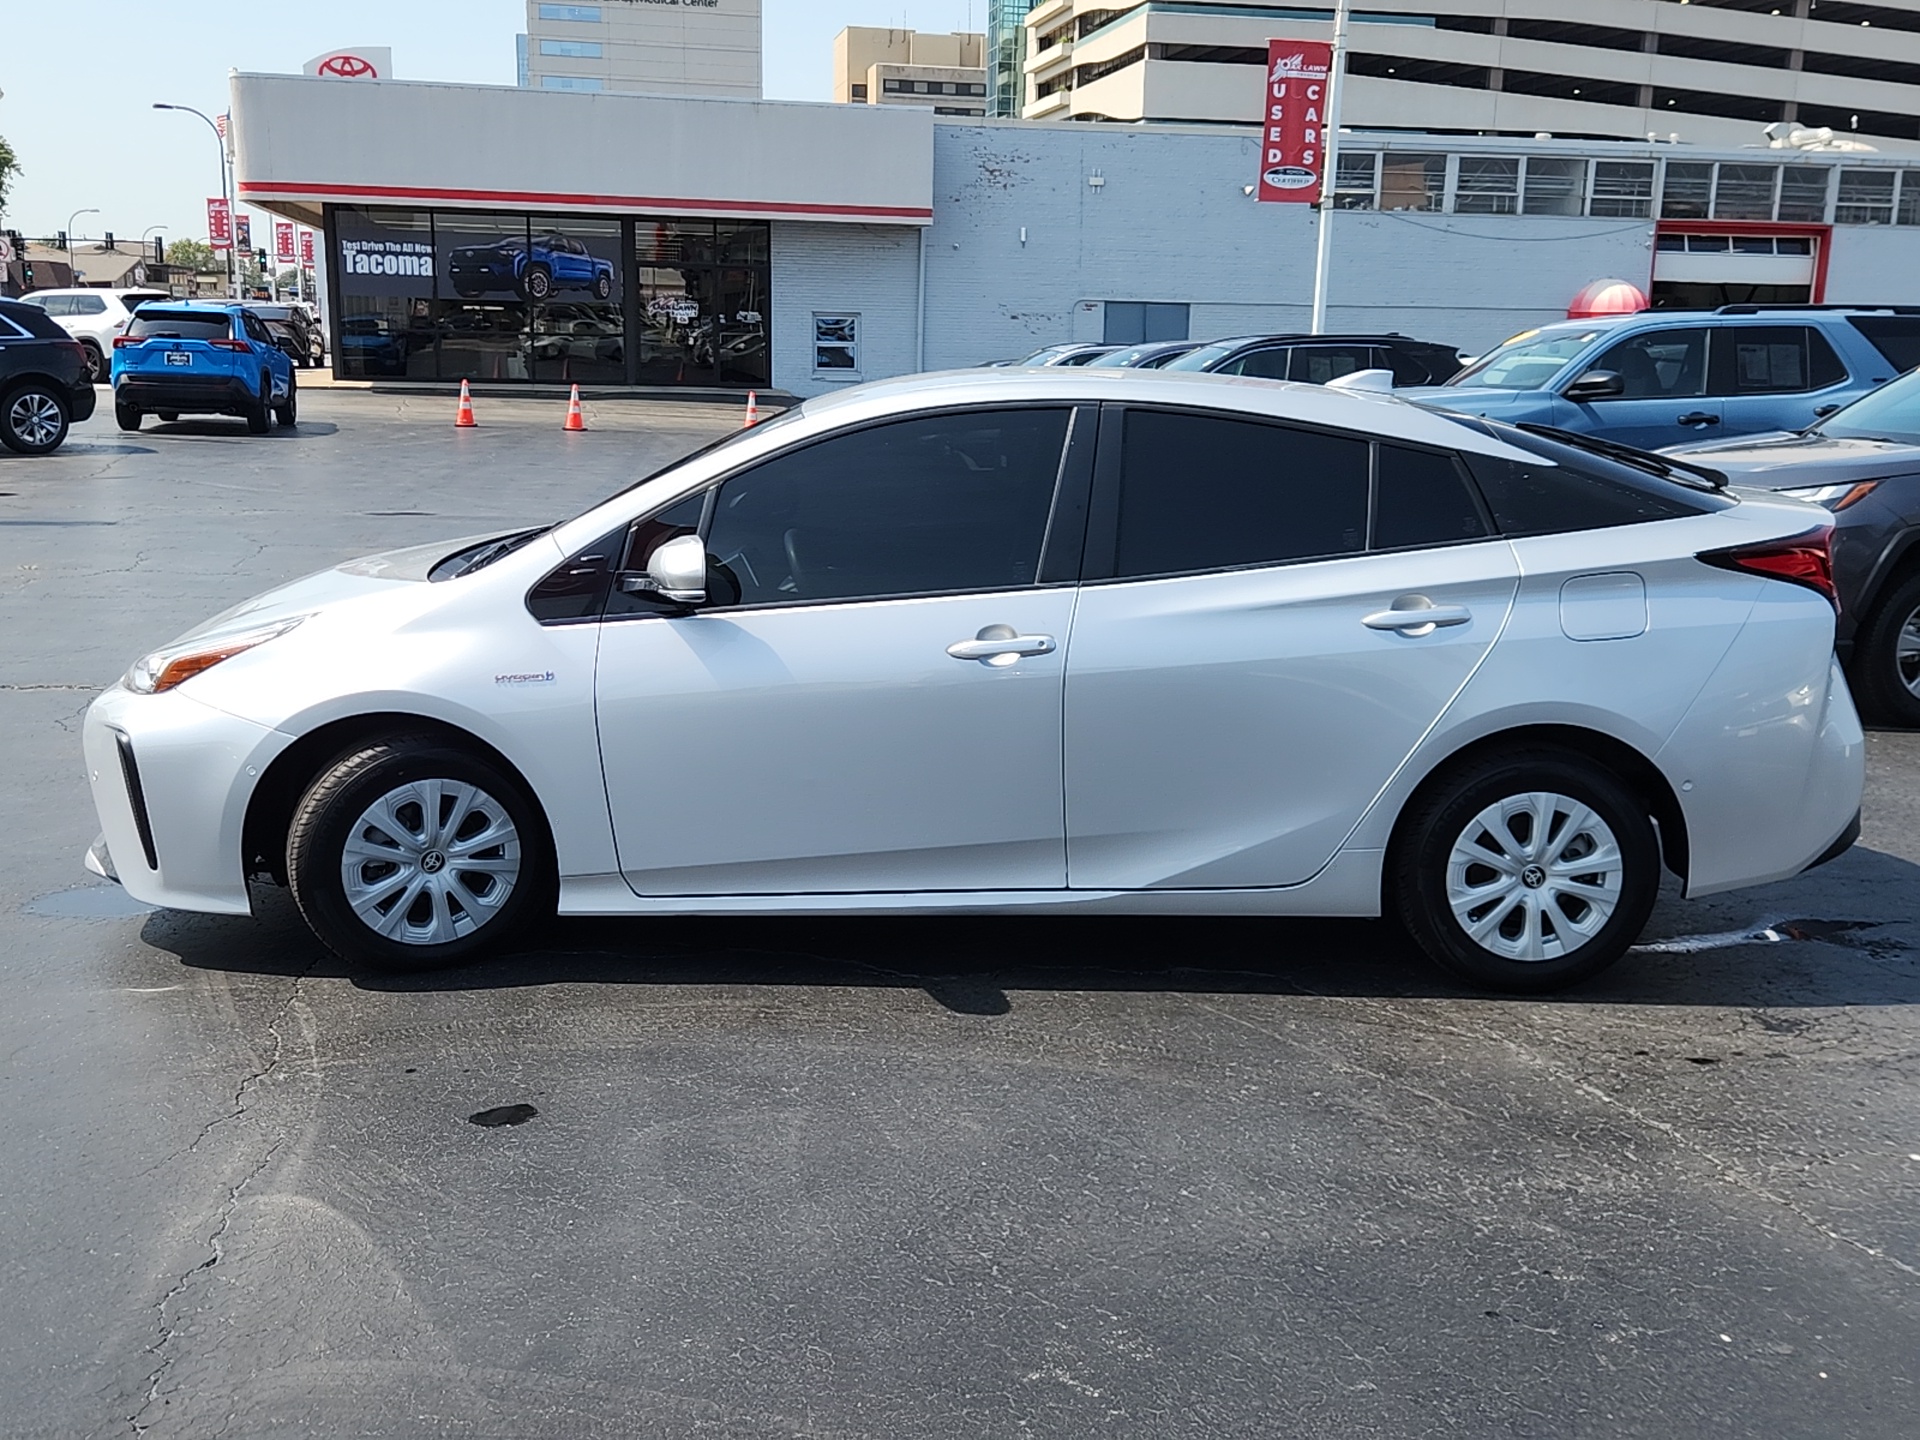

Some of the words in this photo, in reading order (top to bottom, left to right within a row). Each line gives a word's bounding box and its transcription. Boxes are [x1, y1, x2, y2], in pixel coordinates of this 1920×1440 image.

[683, 0, 718, 8] Center
[1268, 83, 1286, 163] USED
[1302, 85, 1320, 165] CARS
[342, 240, 360, 250] Test
[361, 241, 384, 251] Drive
[385, 242, 401, 252] The
[402, 243, 414, 252] All
[415, 244, 437, 253] New
[343, 250, 438, 276] Tacoma
